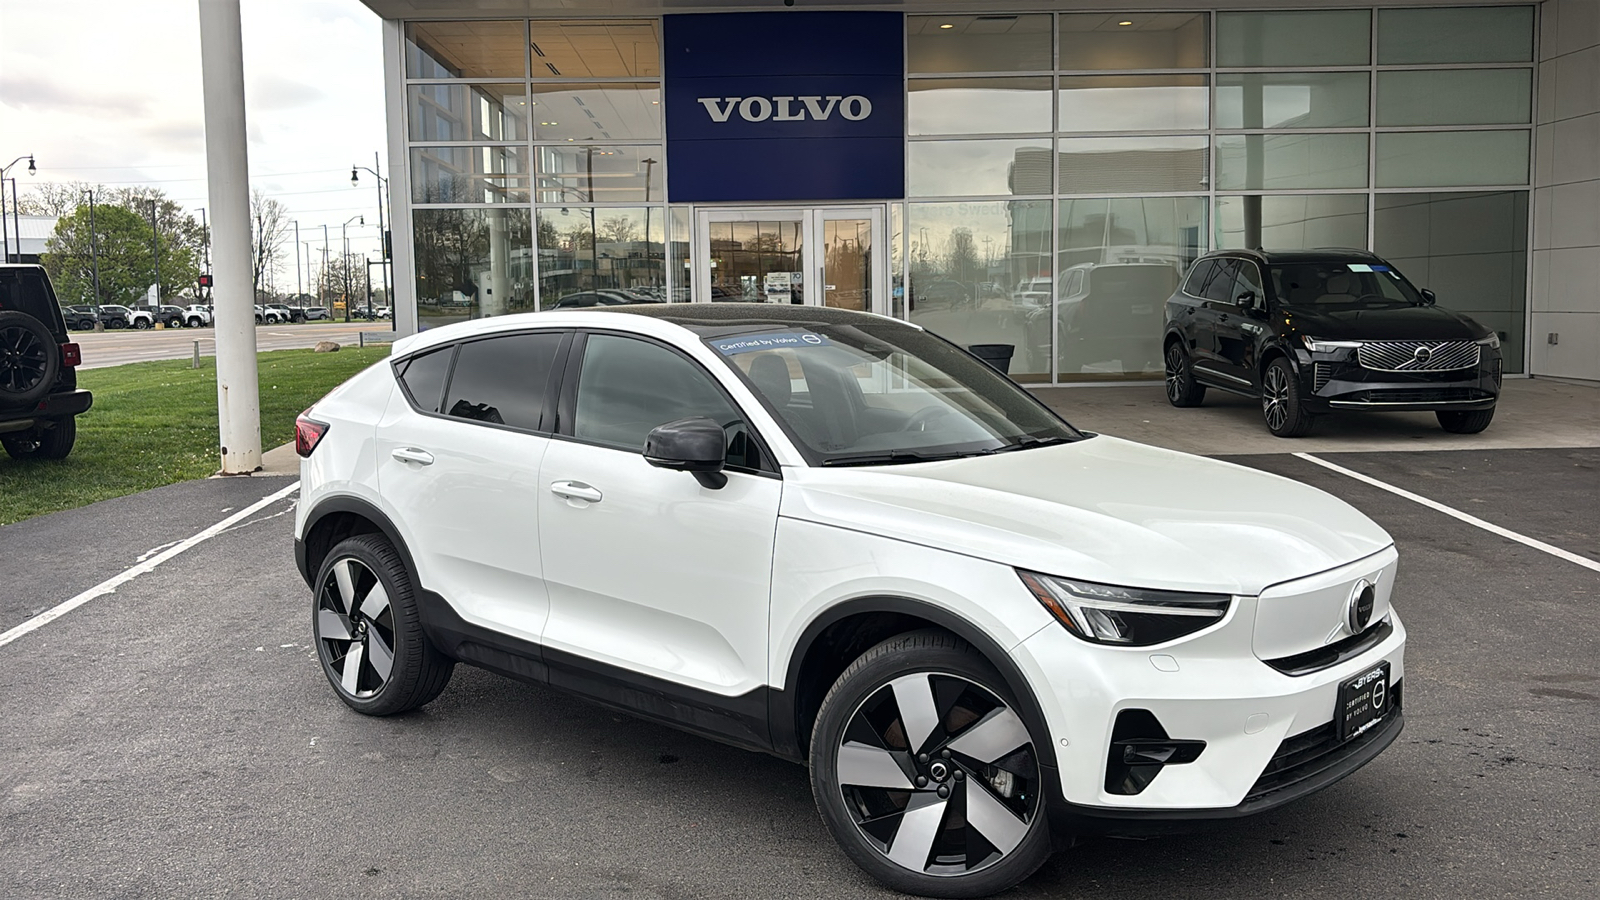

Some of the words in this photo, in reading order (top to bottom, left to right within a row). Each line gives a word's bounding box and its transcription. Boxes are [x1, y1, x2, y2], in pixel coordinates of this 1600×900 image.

[697, 95, 873, 122] VOLVO
[720, 340, 760, 351] Certified
[760, 338, 772, 346] by
[1357, 668, 1381, 687] BYERS
[1346, 691, 1370, 709] CERTIFIED
[1346, 713, 1353, 722] BY
[1353, 703, 1369, 717] VOLVO
